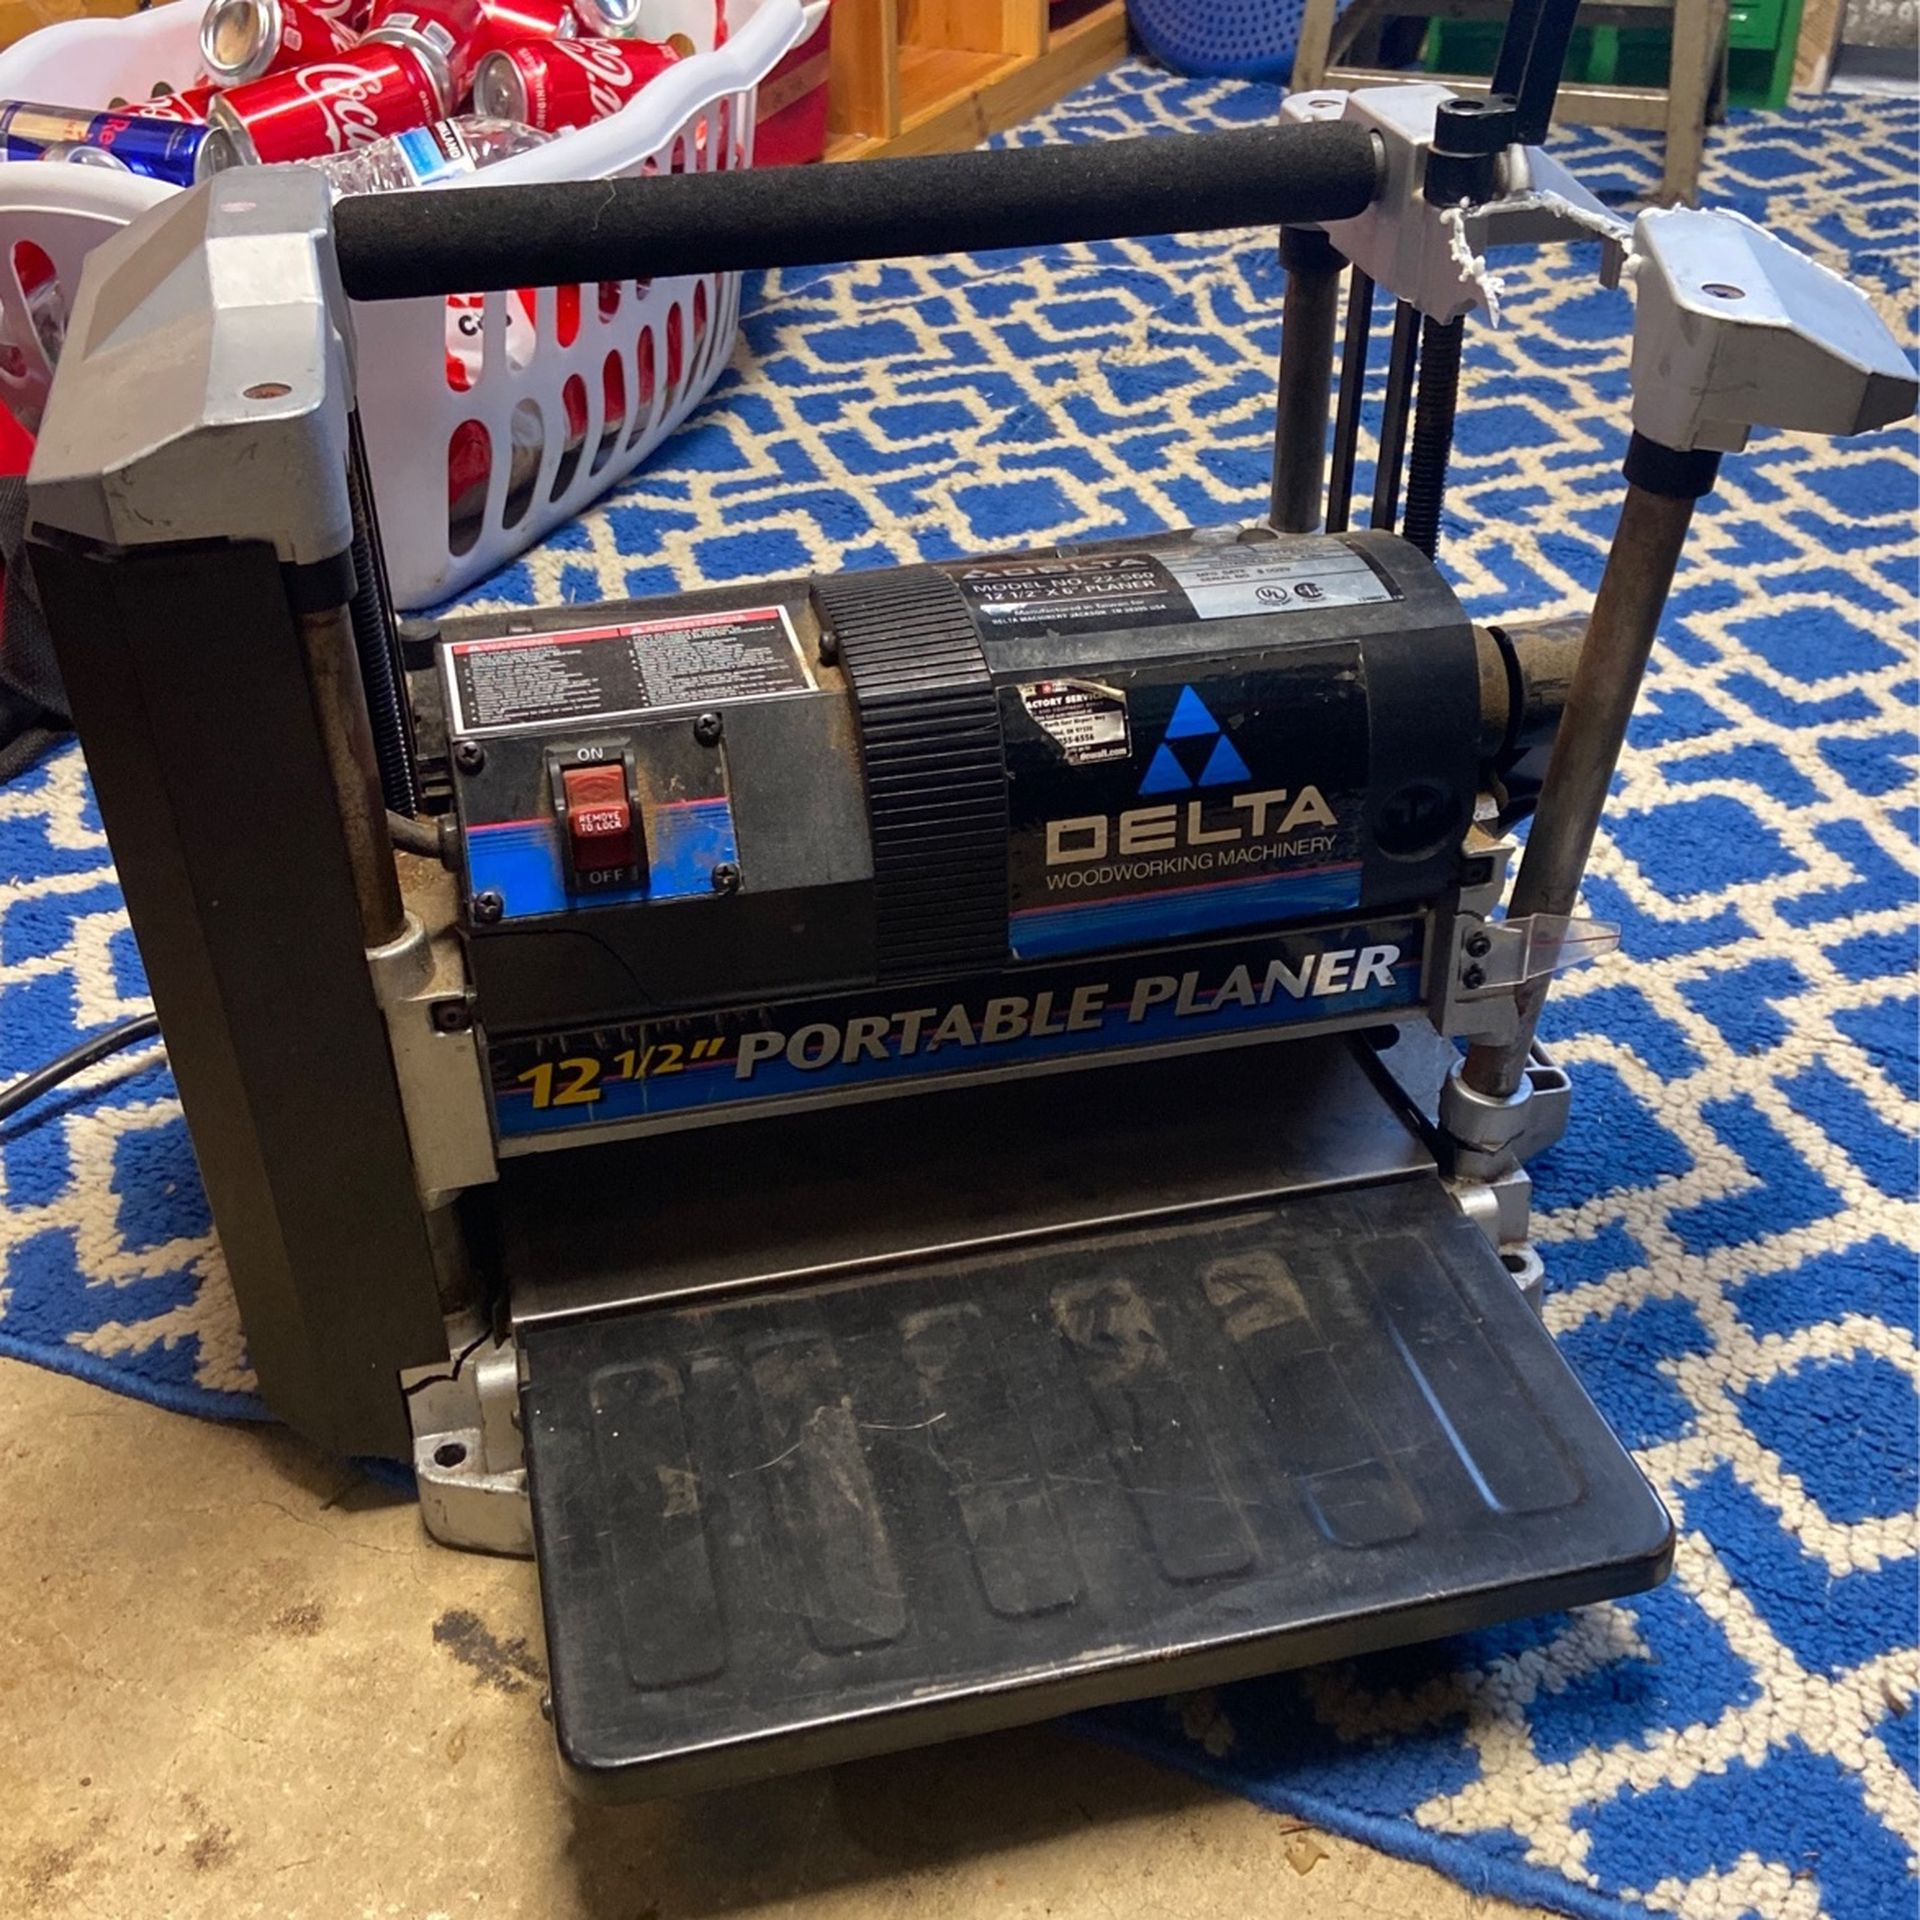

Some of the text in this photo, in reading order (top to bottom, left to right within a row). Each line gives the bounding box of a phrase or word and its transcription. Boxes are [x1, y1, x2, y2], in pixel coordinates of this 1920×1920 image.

[972, 581, 1046, 593] MODEL
[1051, 577, 1088, 588] NO.
[984, 592, 1004, 601] 12
[1047, 587, 1058, 597] X
[1087, 579, 1156, 594] PLANER
[1025, 696, 1062, 709] ACTORY
[577, 748, 603, 761] ON
[579, 811, 621, 824] REMOVE
[1046, 785, 1338, 866] DELTA
[581, 820, 622, 832] TO LOCK
[1046, 835, 1338, 890] WOODWORKING MACHINERY
[589, 868, 624, 884] OFF
[517, 1057, 600, 1109] 12
[734, 983, 1109, 1080] PORTABLE
[1126, 944, 1400, 1022] PLANER
